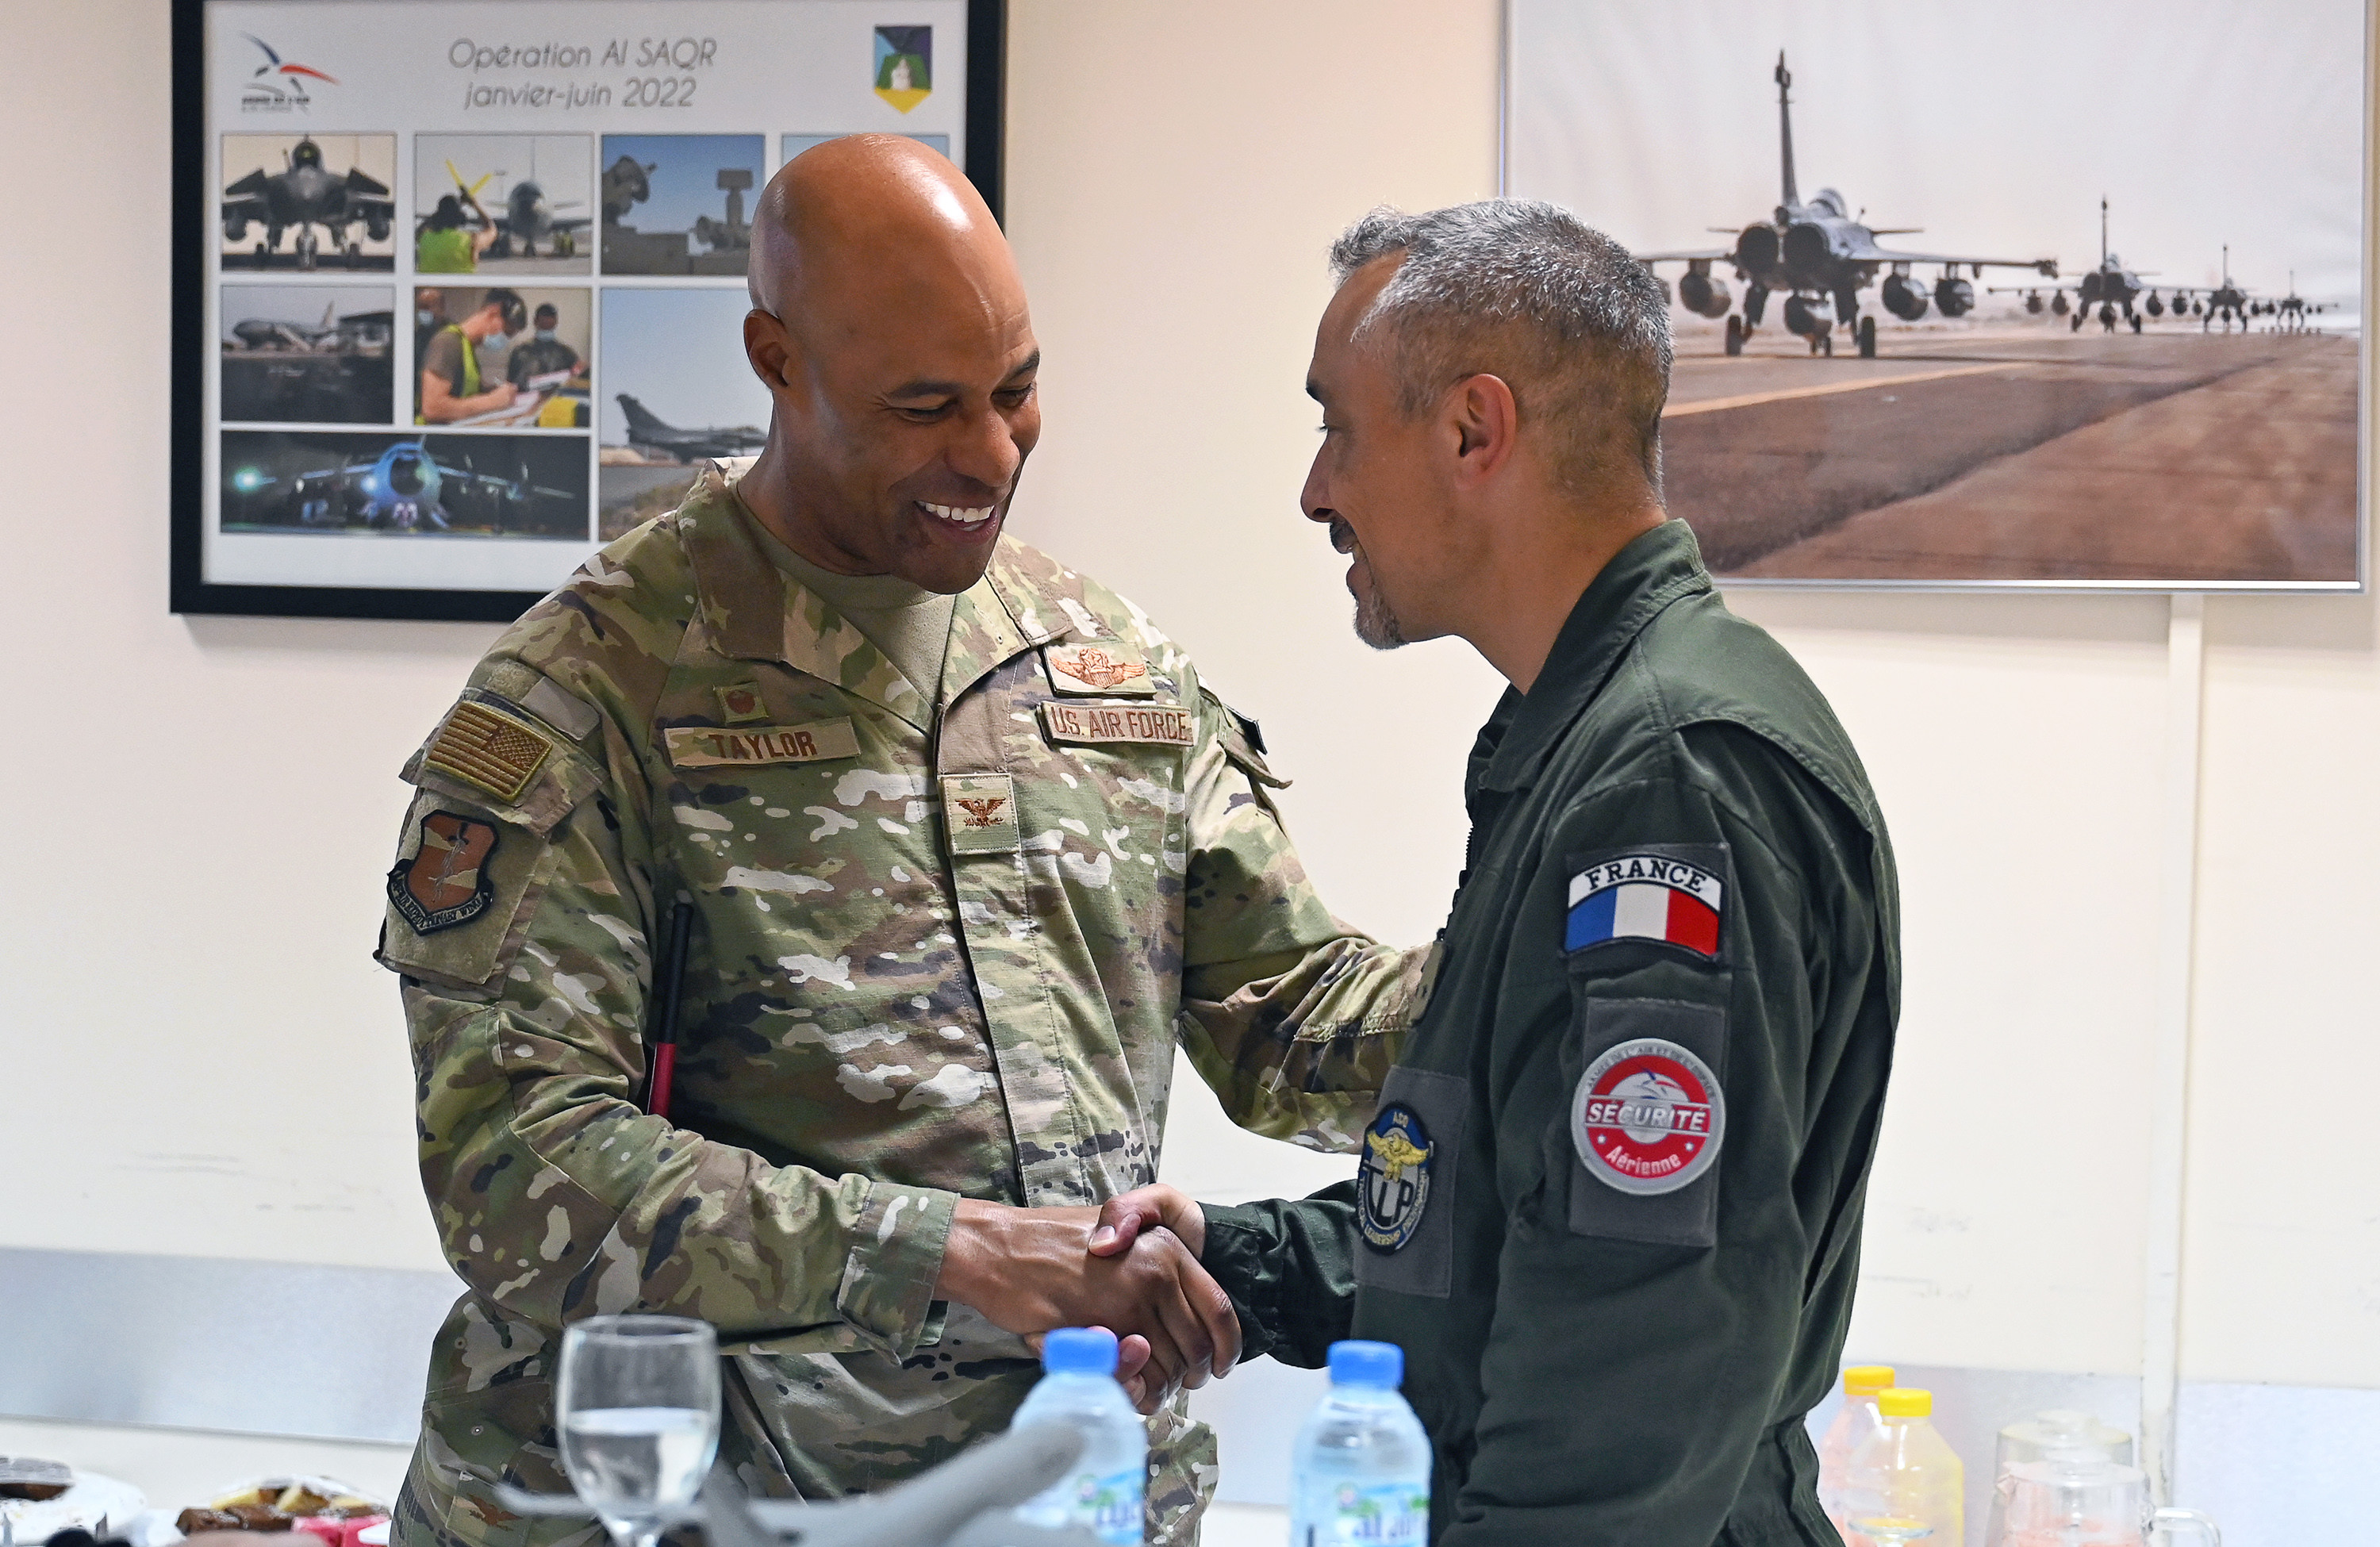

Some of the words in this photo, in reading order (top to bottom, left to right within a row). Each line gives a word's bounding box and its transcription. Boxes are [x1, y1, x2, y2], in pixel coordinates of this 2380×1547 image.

[448, 37, 591, 73] Opération
[636, 37, 717, 70] SAQR
[464, 81, 612, 109] janvier-juin
[623, 76, 697, 107] 2022
[1050, 706, 1084, 735] U.S.
[1089, 710, 1125, 738] AIR
[1125, 710, 1188, 740] FORCE
[708, 731, 818, 760] TAYLOR
[1584, 859, 1707, 893] FRANCE
[1605, 1145, 1682, 1176] Aérienne
